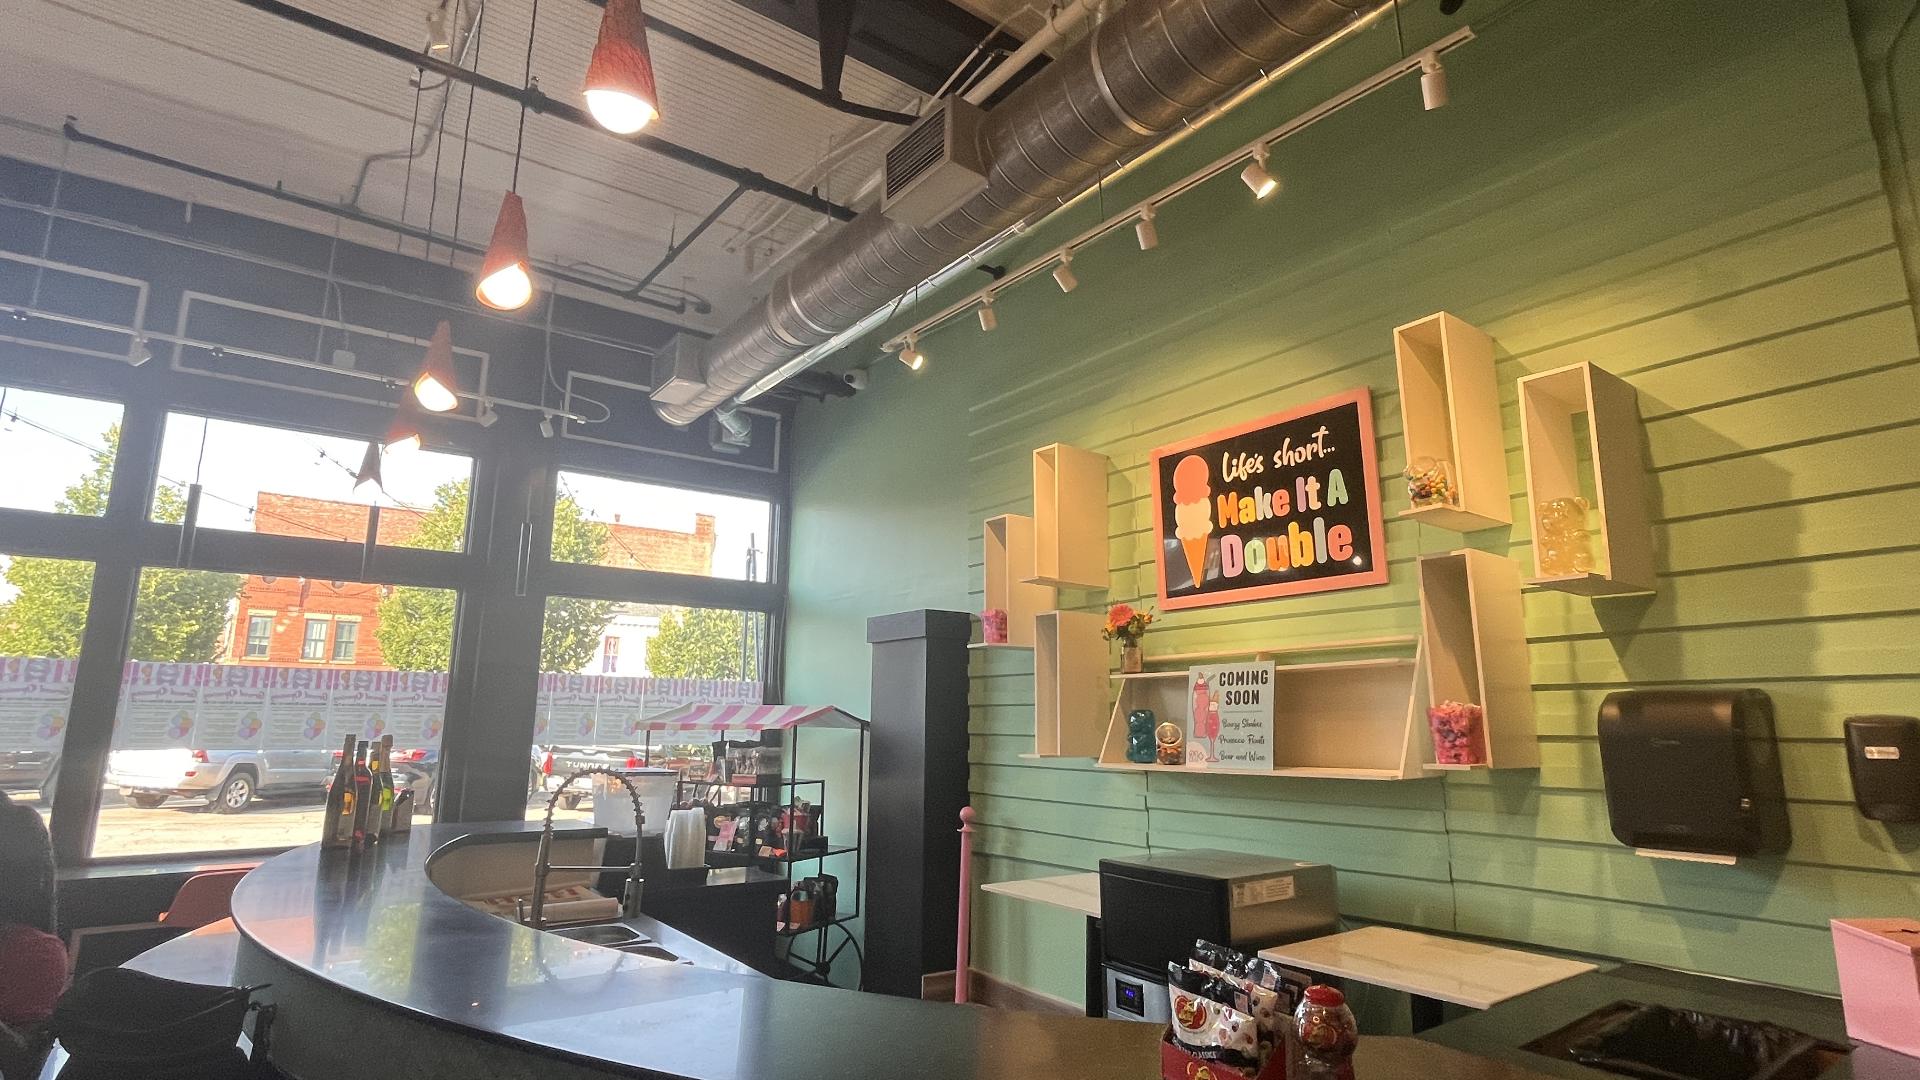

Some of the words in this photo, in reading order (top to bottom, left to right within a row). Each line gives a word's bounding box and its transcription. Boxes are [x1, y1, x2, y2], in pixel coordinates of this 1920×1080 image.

[1273, 425, 1336, 469] short...
[1217, 485, 1291, 529] Make
[1295, 475, 1322, 513] It
[1327, 468, 1349, 507] A
[1219, 669, 1269, 687] COMING
[1225, 689, 1260, 706] SOON
